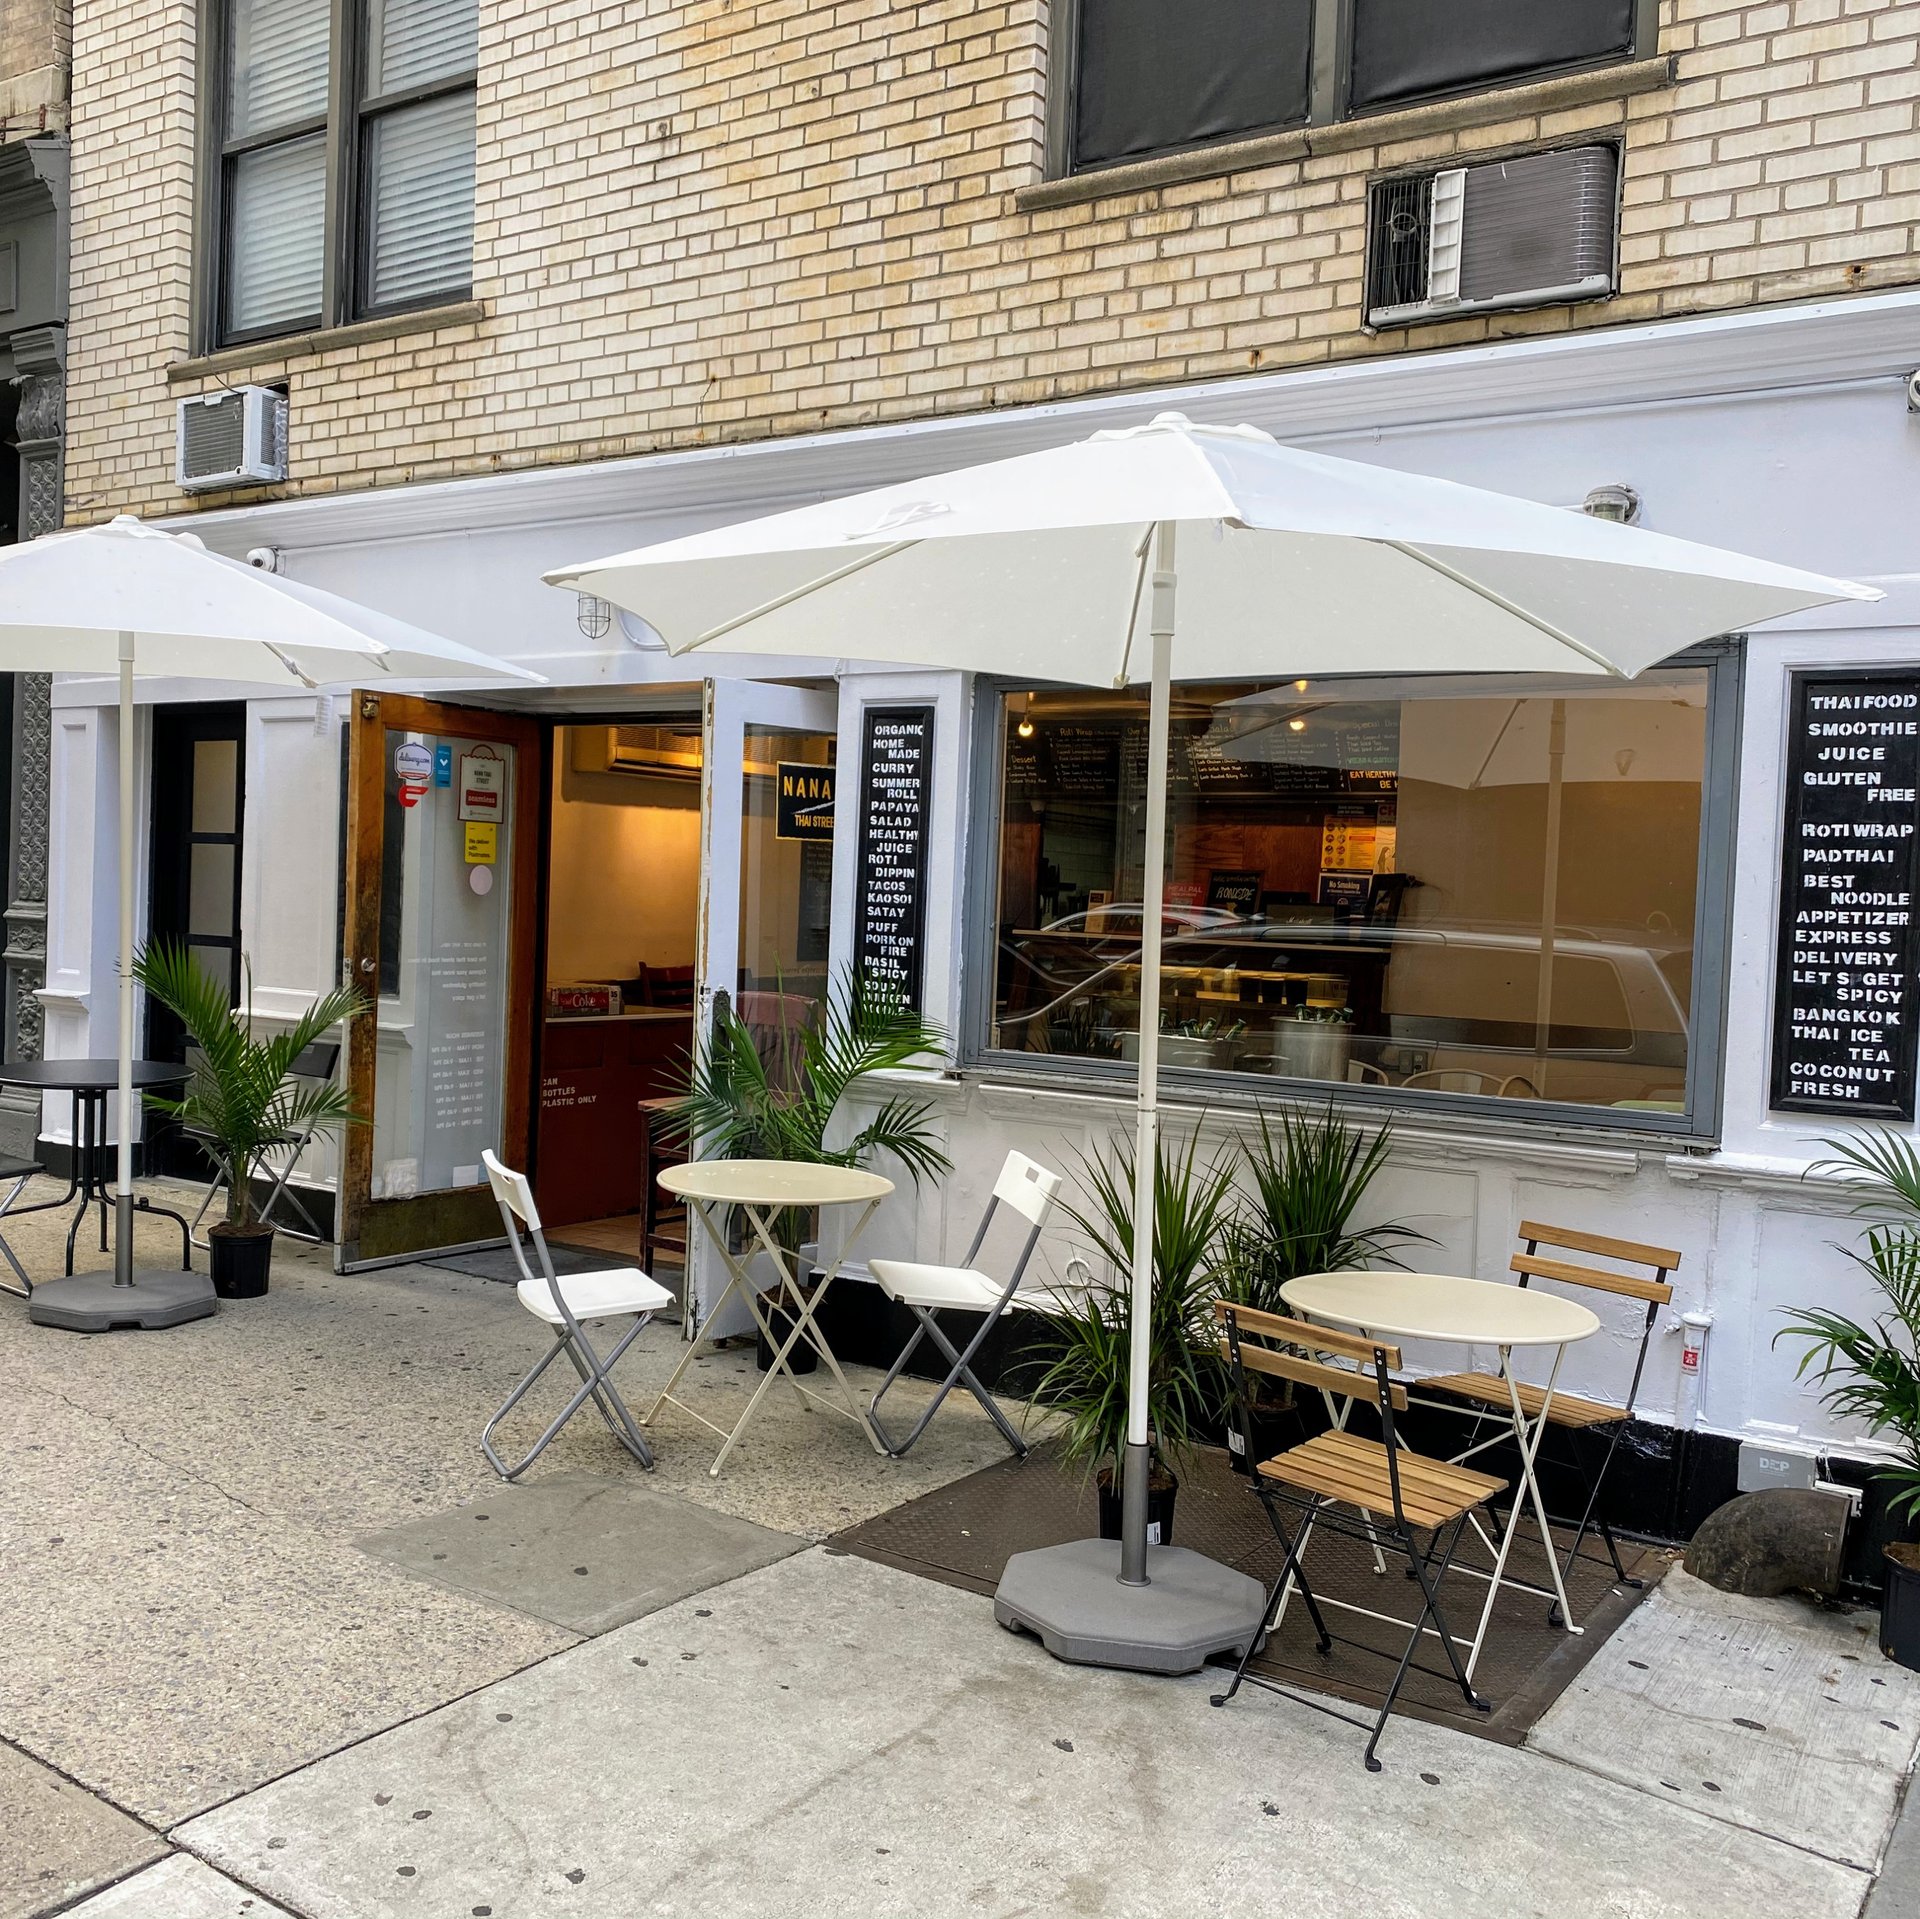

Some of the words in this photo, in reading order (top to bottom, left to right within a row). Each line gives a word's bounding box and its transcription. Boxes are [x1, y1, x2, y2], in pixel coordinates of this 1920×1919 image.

[874, 724, 924, 736] ORGANIC
[1808, 721, 1917, 737] SMOOTHIE
[873, 739, 905, 749] HOME
[888, 749, 920, 759] MADE
[1011, 755, 1037, 764] Dessert
[1818, 747, 1886, 761] JUICE
[872, 763, 914, 774] CURRY
[1349, 770, 1365, 779] EAT
[1365, 769, 1396, 779] HEALTHY
[872, 778, 920, 788] SUMMER
[1379, 780, 1392, 789] BE
[1803, 771, 1881, 786] GLUTEN
[783, 776, 831, 800] NANA
[887, 789, 917, 800] ROLL
[1867, 788, 1916, 802] FREE
[871, 801, 920, 813] PAPAYA
[794, 814, 812, 827] THAI
[813, 816, 835, 828] STREE
[869, 815, 912, 827] SALAD
[869, 829, 919, 841] HEALTHY
[876, 842, 913, 853] JUICE
[868, 854, 897, 865] ROTI
[875, 867, 915, 878] DIPPIN
[867, 880, 906, 891] TACOS
[1328, 880, 1337, 888] No
[1337, 881, 1360, 891] Smoking
[1804, 874, 1856, 889] BEST
[1830, 892, 1911, 906] NOODLE
[867, 906, 905, 918] SATAY
[1796, 910, 1909, 926] APPETIZER
[867, 922, 898, 933] PUFF
[865, 934, 896, 945] PORK
[898, 936, 914, 947] ON
[1795, 930, 1892, 945] EXPRESS
[880, 945, 907, 957] FIRE
[864, 956, 900, 968] BASIL
[1794, 951, 1898, 966] DELIVERY
[872, 967, 908, 980] SPICY
[1862, 973, 1904, 987] GET
[572, 993, 597, 1008] Coke
[1836, 988, 1903, 1004] SPICY
[1793, 1008, 1901, 1025] BANGKOK
[1791, 1025, 1839, 1041] THAI
[1851, 1029, 1883, 1043] ICE
[1848, 1048, 1890, 1062] TEA
[1790, 1062, 1895, 1082] COCONUT
[543, 1086, 576, 1097] BOTTLES
[1791, 1081, 1860, 1098] FRESH
[542, 1097, 574, 1108] PLASTIC
[578, 1095, 597, 1104] ONLY
[1759, 1457, 1791, 1472] DEP
